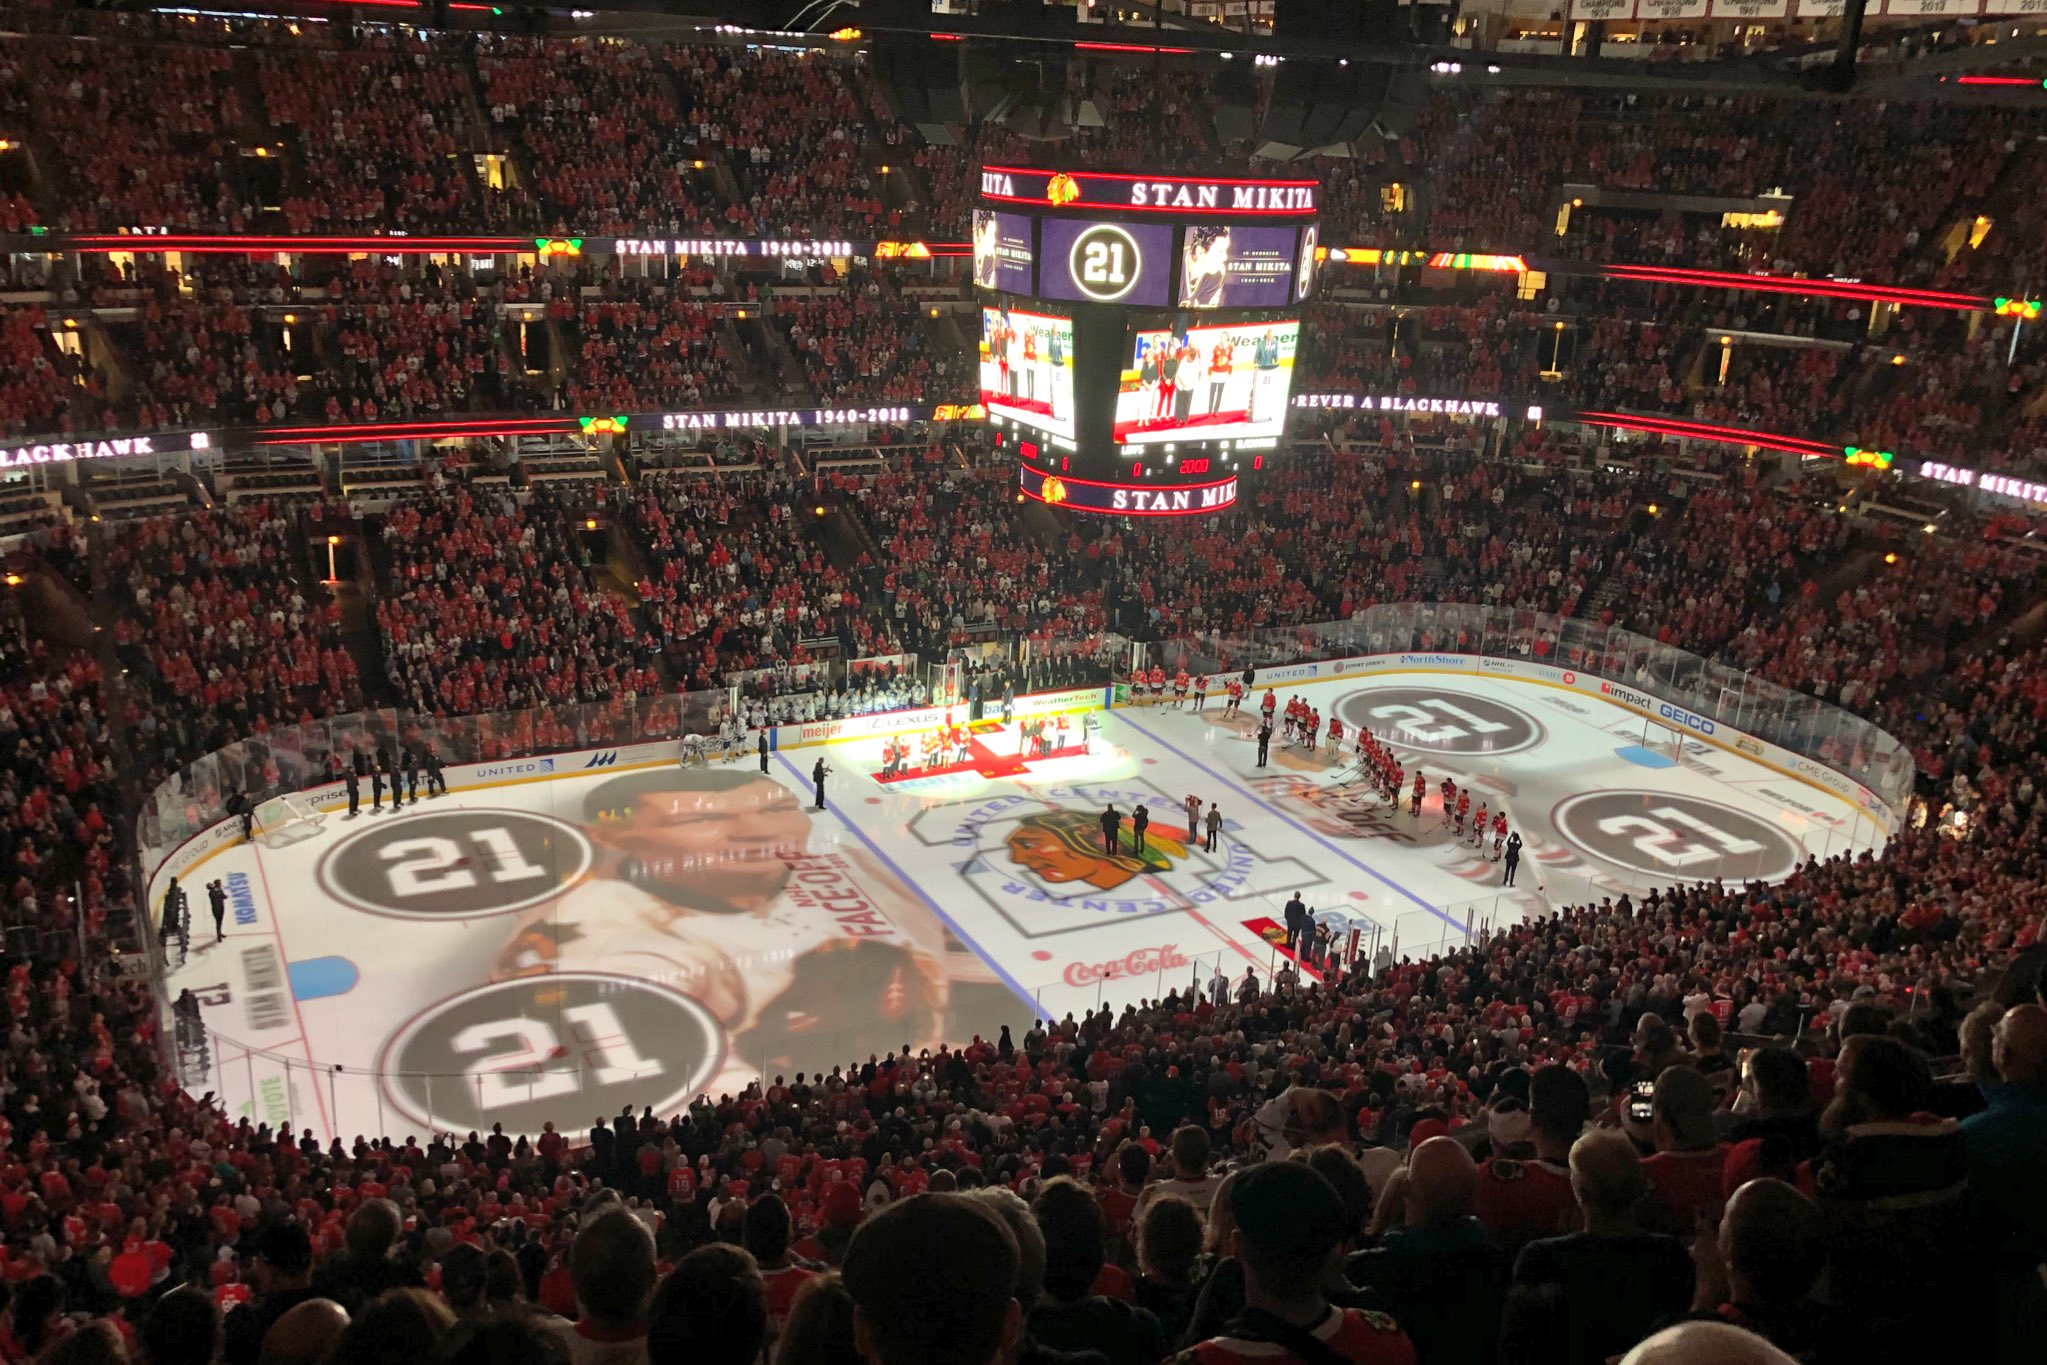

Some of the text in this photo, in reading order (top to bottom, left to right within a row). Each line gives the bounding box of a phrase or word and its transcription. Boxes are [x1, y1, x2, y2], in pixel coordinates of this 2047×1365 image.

[1827, 5, 1845, 16] 201
[1131, 183, 1313, 209] STAN MIKITA
[615, 240, 852, 256] STAN MIKITA 1940-2018
[1084, 242, 1124, 282] 21
[1228, 262, 1290, 271] STAN MIKITA
[1292, 394, 1499, 416] REVER A BLACKHAWK
[663, 407, 909, 429] STAN MIKITA 1940-2018
[1920, 461, 1974, 485] STAN
[1113, 490, 1190, 511] STAN
[1406, 655, 1466, 665] NorthShore
[1267, 669, 1305, 680] UNITED
[1033, 692, 1098, 708] WeatherTech
[1610, 686, 1652, 710] impact
[802, 723, 843, 739] meijer
[1369, 698, 1512, 742] 21
[1660, 703, 1715, 736] GEICO
[477, 763, 536, 778] UNITED
[1798, 761, 1850, 793] CME Group
[306, 789, 349, 806] prise
[951, 794, 1026, 847] UNITED
[1599, 806, 1765, 867] 21
[379, 827, 546, 897] 21
[1001, 842, 1254, 913] UNITED CENTER
[227, 871, 258, 925] KOMATSU
[774, 851, 896, 936] FACE-OFF
[782, 884, 818, 908] NHL
[1062, 944, 1190, 988] Coca-Cola
[450, 1002, 664, 1110] 21
[260, 1075, 289, 1129] OYOTE
[675, 1180, 689, 1192] 19
